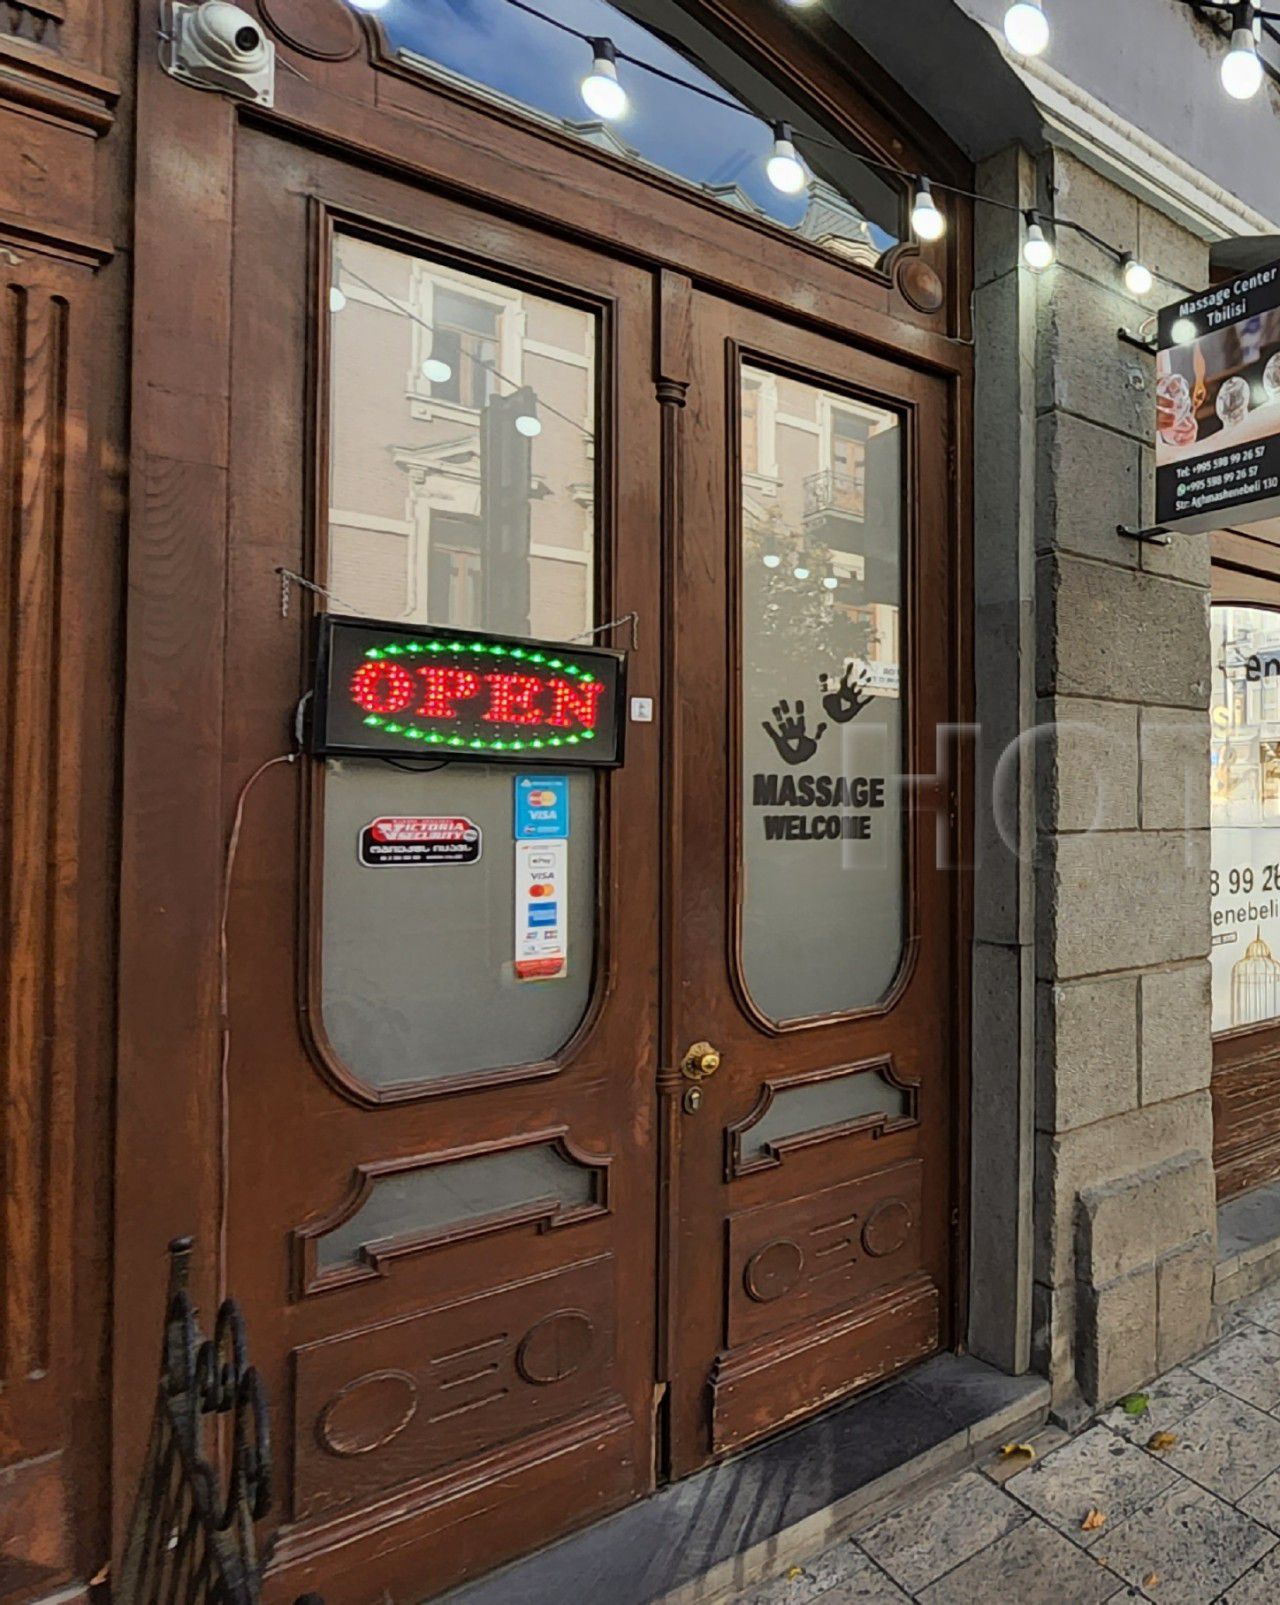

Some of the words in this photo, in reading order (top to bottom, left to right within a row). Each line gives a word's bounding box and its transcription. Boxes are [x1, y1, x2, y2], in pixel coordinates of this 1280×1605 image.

[1179, 287, 1231, 318] Massage
[1233, 267, 1278, 296] Center
[1206, 298, 1247, 327] Tbilisi
[1192, 460, 1212, 474] +995
[1230, 452, 1242, 464] 99
[1242, 449, 1254, 461] 26
[1255, 445, 1266, 458] 57
[1223, 471, 1235, 483] 99
[1236, 468, 1247, 480] 26
[1248, 465, 1259, 477] 57
[1262, 476, 1279, 491] 130
[349, 660, 606, 730] OPEN
[753, 773, 885, 808] MASSAGE
[530, 810, 558, 821] VISA
[763, 815, 872, 841] WELCOME
[531, 871, 555, 881] VISA
[1229, 867, 1254, 895] 99
[1212, 898, 1279, 926] enebeli
